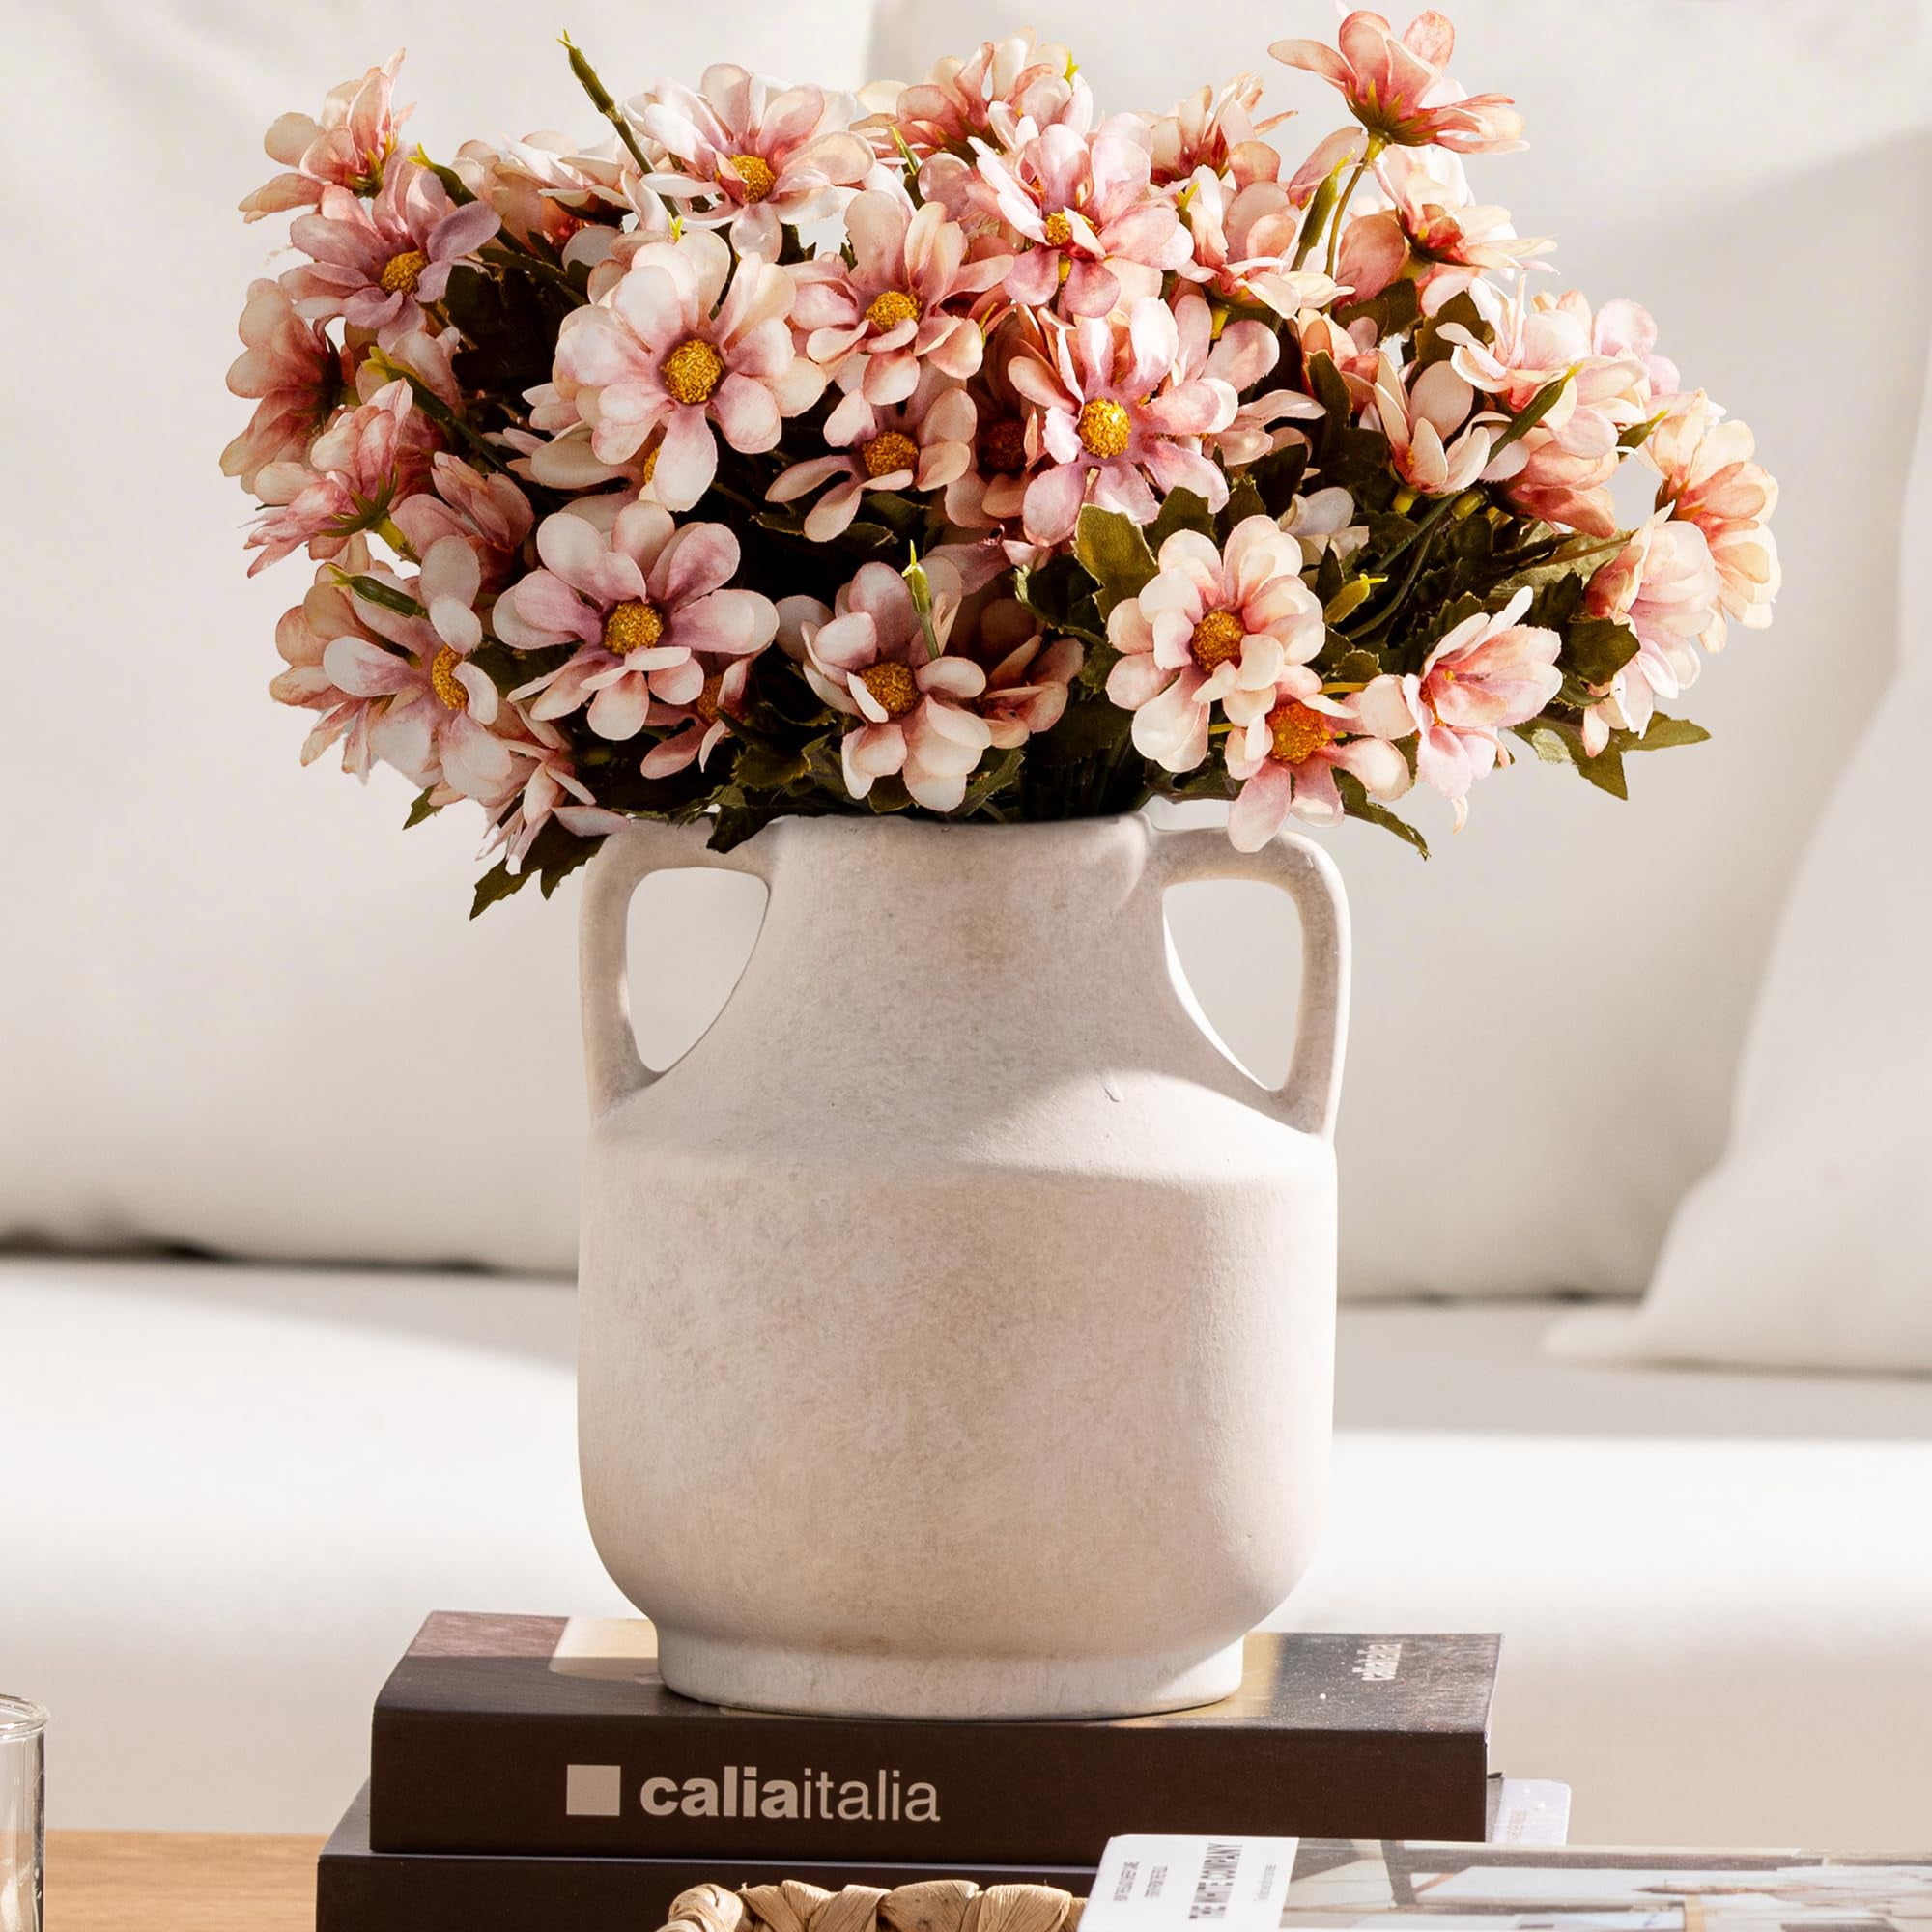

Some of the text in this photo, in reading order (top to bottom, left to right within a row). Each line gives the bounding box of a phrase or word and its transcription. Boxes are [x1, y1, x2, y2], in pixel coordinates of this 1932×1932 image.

[639, 1765, 941, 1823] caliaitalia
[1188, 1843, 1243, 1919] THE WHITE COMPANY
